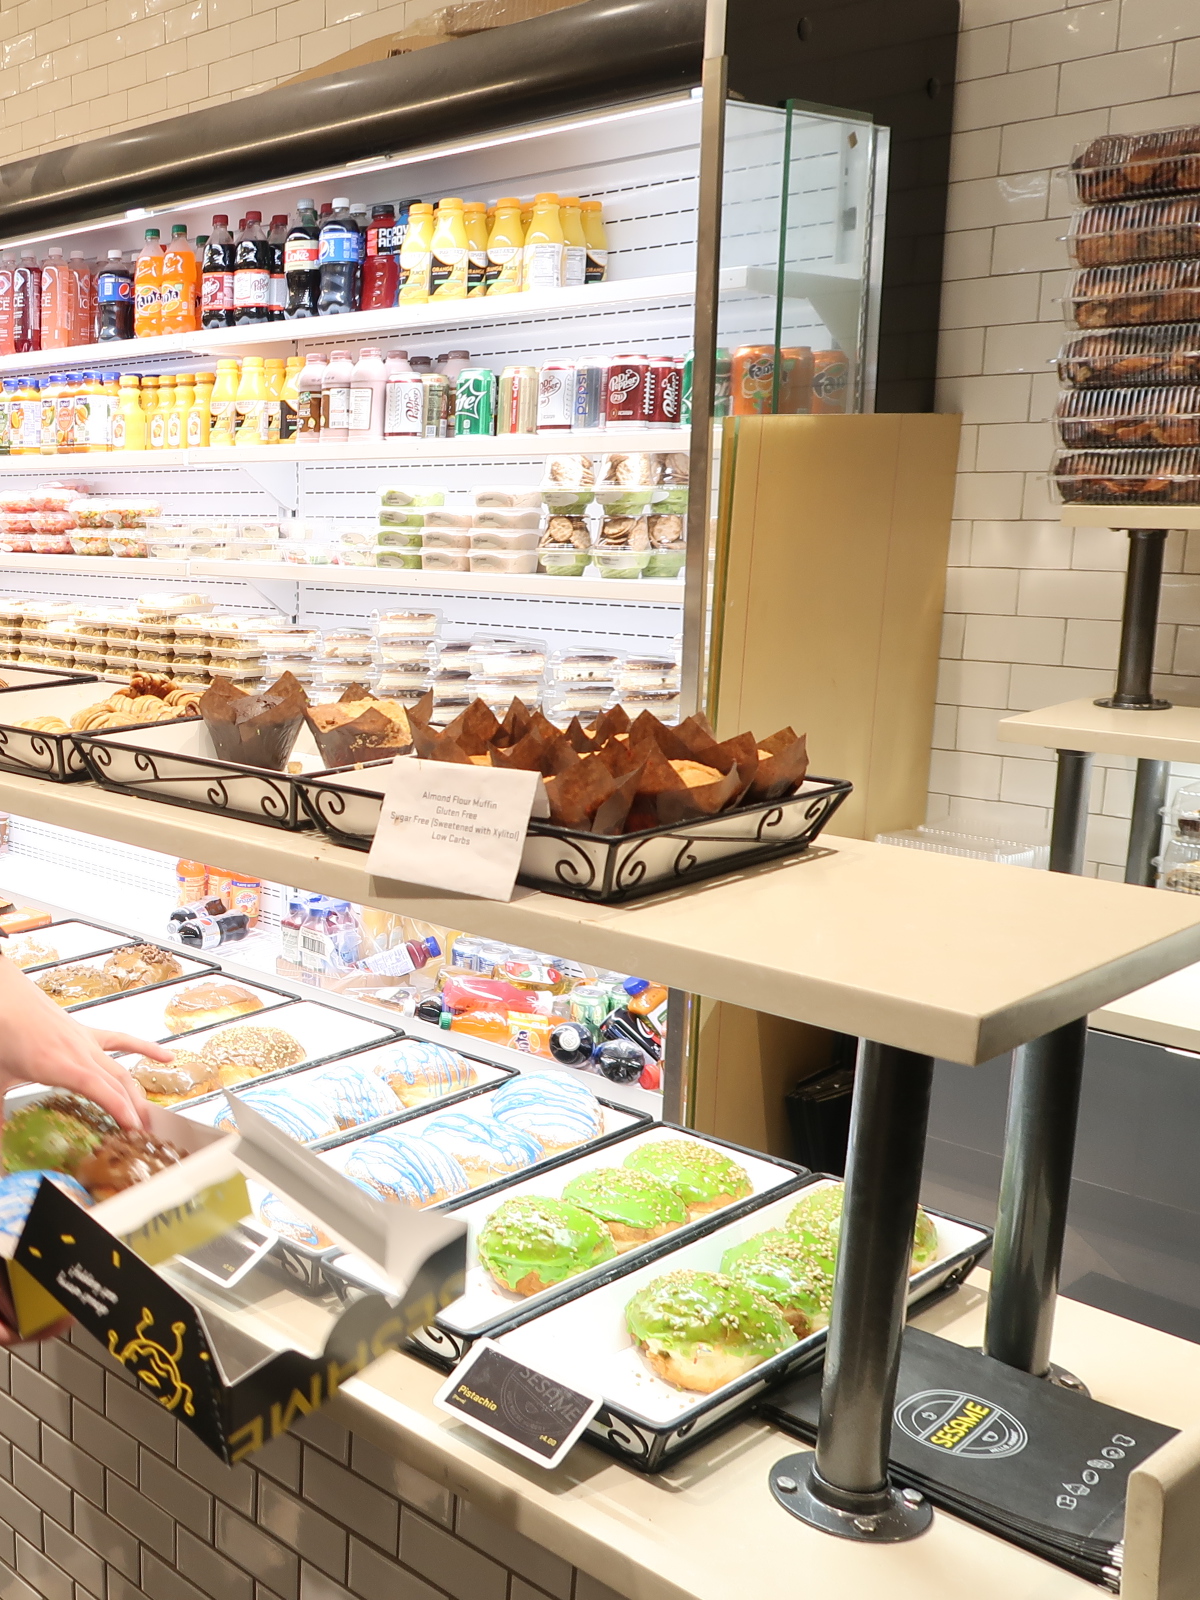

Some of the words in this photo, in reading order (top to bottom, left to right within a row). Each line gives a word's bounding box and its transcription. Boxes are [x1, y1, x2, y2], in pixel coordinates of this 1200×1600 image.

[393, 224, 408, 237] POW
[285, 249, 310, 262] Coke
[161, 289, 179, 303] nta
[618, 372, 630, 383] Dr
[749, 363, 775, 380] Fant
[609, 376, 638, 391] Pepper
[456, 394, 475, 411] ite
[575, 373, 589, 416] pepsi
[422, 791, 451, 804] Almond
[452, 795, 471, 806] Flour
[473, 798, 497, 810] Muffin
[436, 806, 460, 817] Gluten
[461, 810, 477, 820] Free
[390, 811, 412, 823] Sugar
[413, 815, 430, 826] Free
[475, 825, 491, 836] with
[431, 832, 447, 841] Low
[449, 834, 471, 846] Carbs
[515, 1030, 531, 1053] nta
[457, 1384, 498, 1411] Pistachio
[519, 1366, 582, 1423] SESAME
[930, 1401, 990, 1449] SESAME
